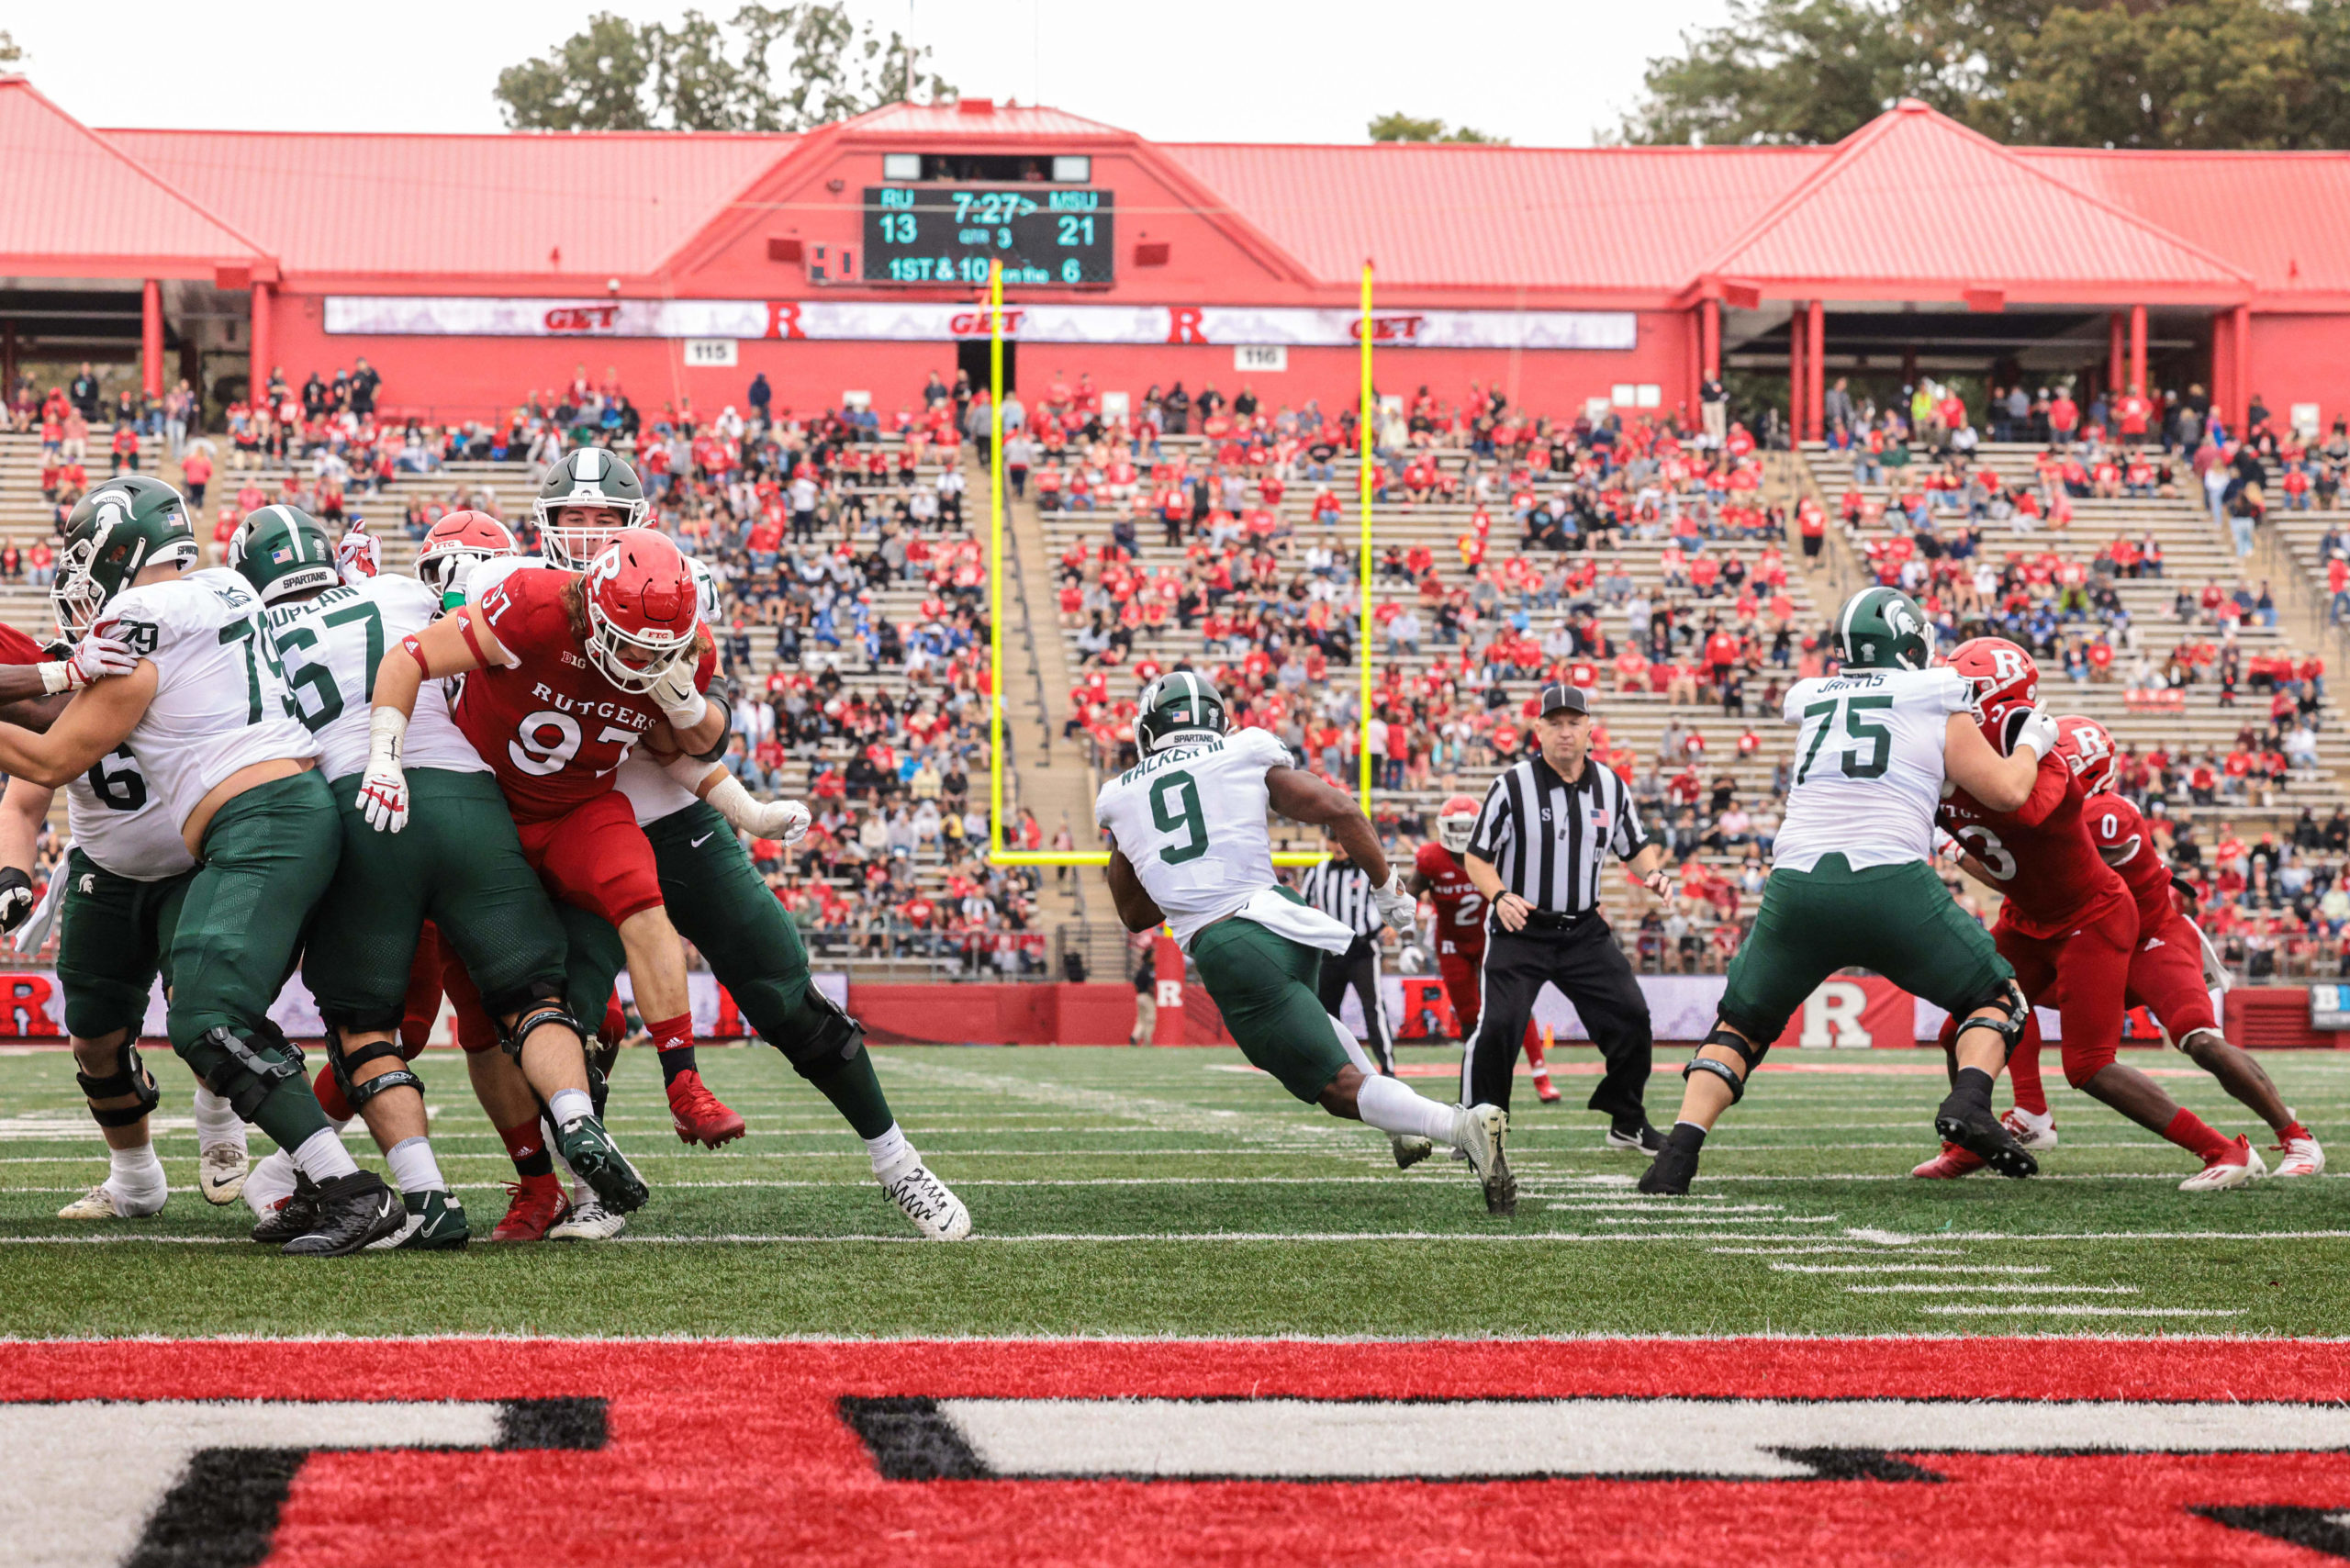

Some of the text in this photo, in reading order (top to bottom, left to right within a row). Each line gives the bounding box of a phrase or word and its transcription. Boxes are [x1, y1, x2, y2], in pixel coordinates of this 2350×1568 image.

[881, 188, 914, 209] RU
[1049, 191, 1098, 212] MSU
[879, 213, 918, 243] 13
[997, 228, 1013, 249] 3
[1058, 216, 1094, 245] 21
[889, 257, 934, 281] 1ST
[958, 257, 990, 282] 10
[1061, 258, 1081, 284] 6
[544, 305, 621, 330] GET
[763, 300, 807, 339] R
[1167, 306, 1210, 343] R
[695, 345, 726, 359] 115
[283, 571, 328, 589] SPARTANS
[588, 544, 621, 596] R
[267, 583, 361, 632] UPLAIN
[120, 620, 159, 655] 79
[1990, 649, 2027, 679] R
[532, 681, 657, 731] RUTGERS
[508, 710, 642, 778] 97
[1174, 734, 1214, 744] SPARTANS
[1796, 695, 1895, 786] 75
[2071, 726, 2108, 756] R
[89, 742, 147, 811] 6
[1121, 748, 1200, 786] WALKER
[1149, 769, 1209, 866] 9
[1541, 807, 1551, 822] S
[2101, 813, 2118, 839] 0
[1958, 825, 2017, 880] 3
[1455, 893, 1483, 926] 2
[1441, 940, 1456, 954] R
[0, 975, 61, 1036] R
[1157, 980, 1183, 1007] R
[1799, 981, 1872, 1048] R
